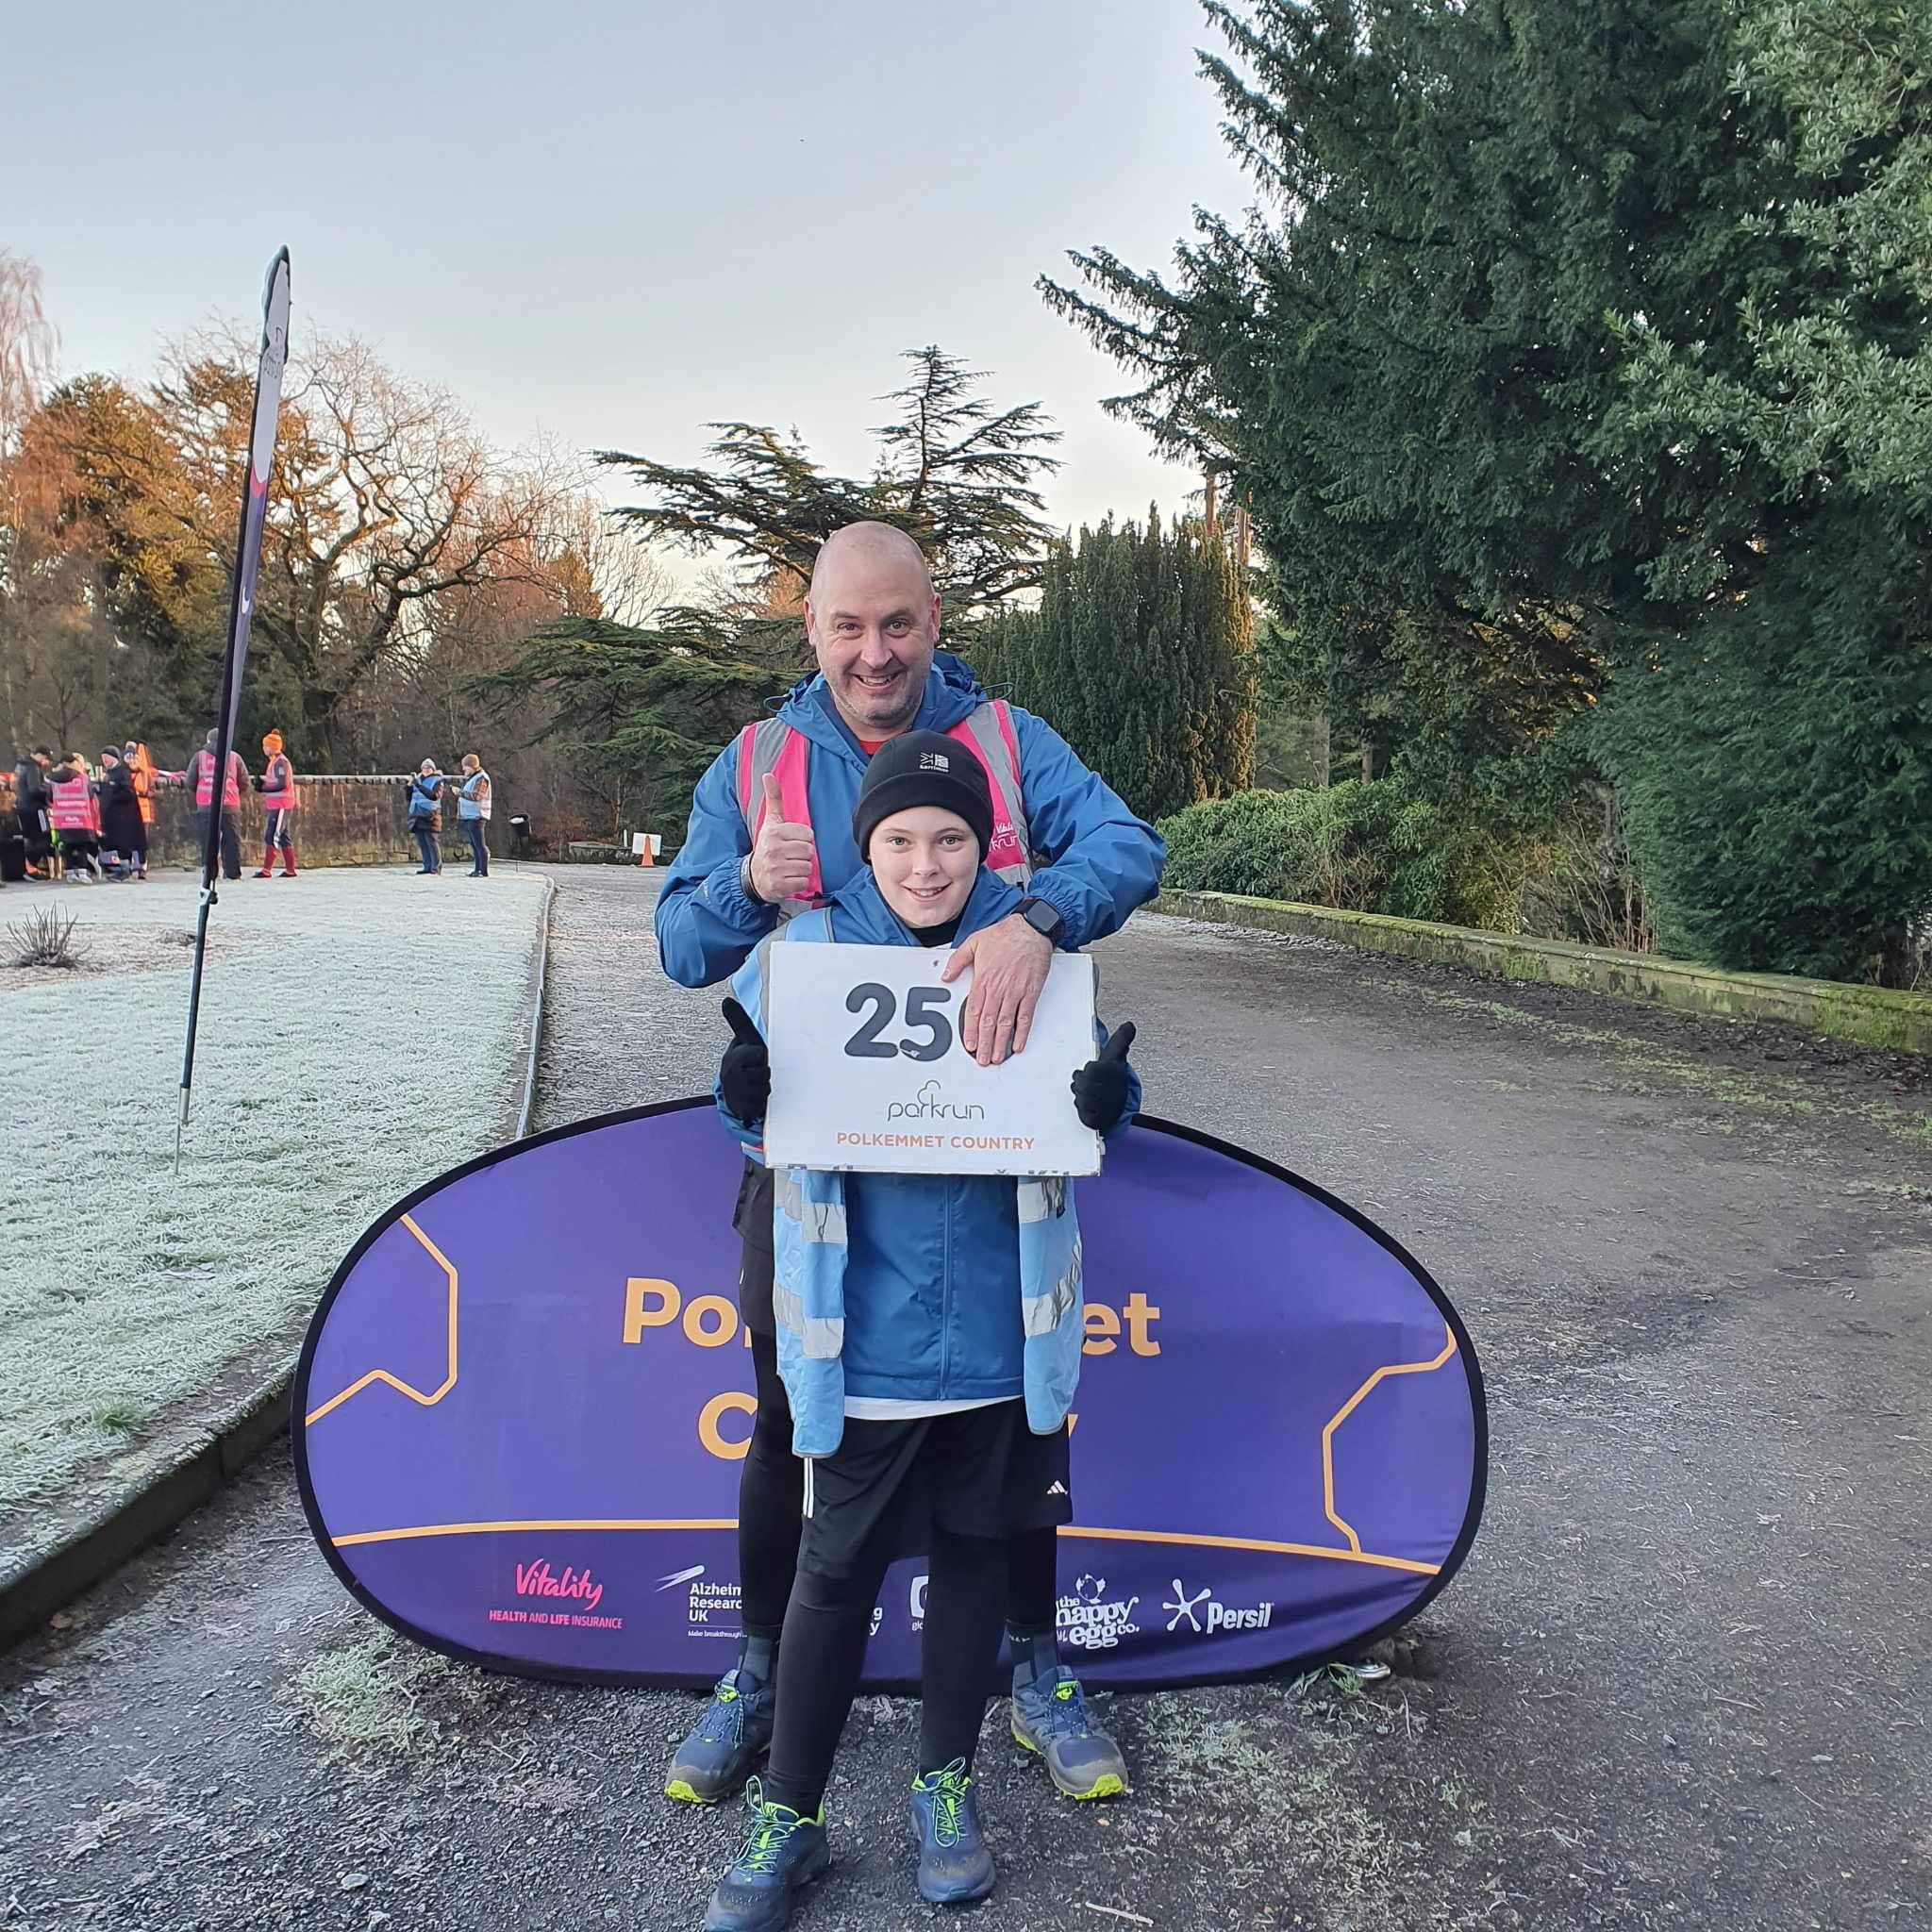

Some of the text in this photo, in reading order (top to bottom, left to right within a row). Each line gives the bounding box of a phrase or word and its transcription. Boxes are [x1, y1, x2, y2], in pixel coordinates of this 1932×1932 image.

[844, 982, 1016, 1066] 25
[888, 1083, 985, 1122] parkrun
[837, 1131, 1035, 1150] POLKEMMET COUNTRY
[516, 1558, 603, 1610] Vitality
[689, 1609, 708, 1622] UK
[1056, 1596, 1140, 1628] happy
[1059, 1595, 1080, 1607] the
[489, 1610, 623, 1629] HEALTH AND LIFE INSURANCE
[1207, 1602, 1273, 1635] Persil
[1069, 1623, 1119, 1650] egg
